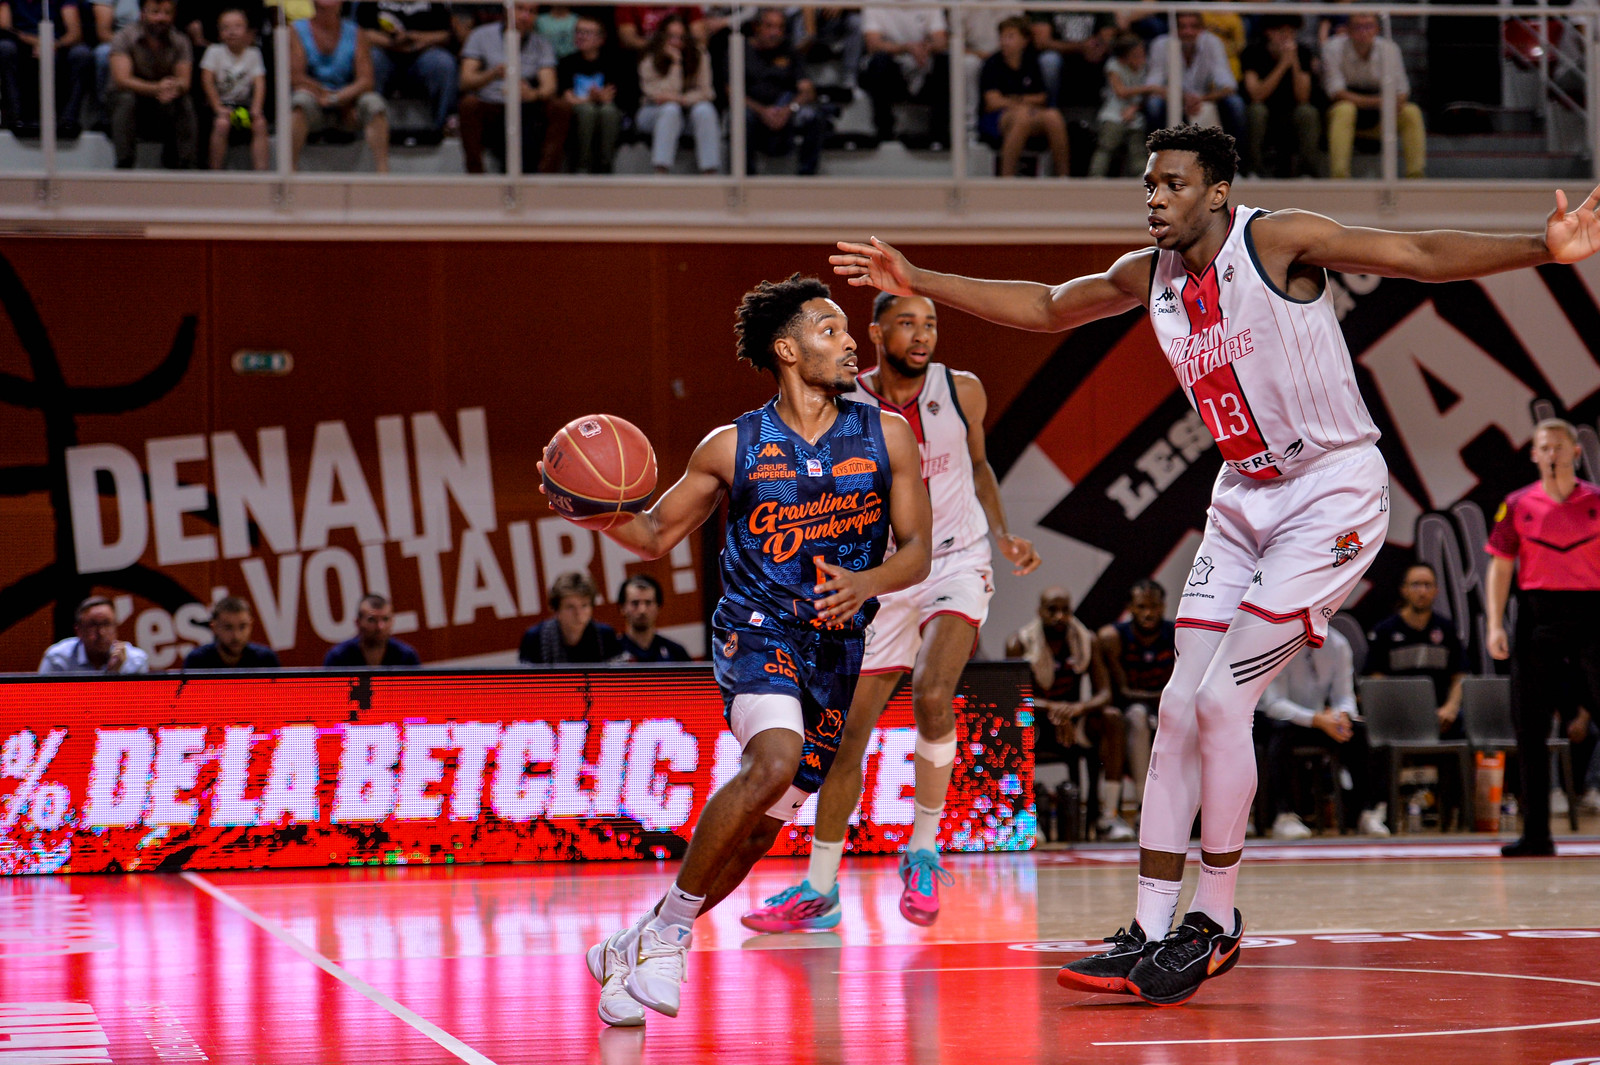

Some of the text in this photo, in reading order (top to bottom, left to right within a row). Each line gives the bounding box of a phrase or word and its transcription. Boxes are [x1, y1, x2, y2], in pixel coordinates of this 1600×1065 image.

[1169, 317, 1229, 366] DENAIN
[1173, 328, 1254, 392] VOLTAIRE
[1203, 392, 1250, 442] 13
[66, 406, 497, 575] DENAIN
[749, 471, 796, 481] LEMPEREUR
[849, 464, 876, 474] TOITURE
[749, 492, 860, 535] Gravelines
[762, 508, 882, 563] Dunkerque
[82, 727, 208, 828] DE
[209, 724, 320, 826] LA
[331, 718, 699, 831] BETCLIC
